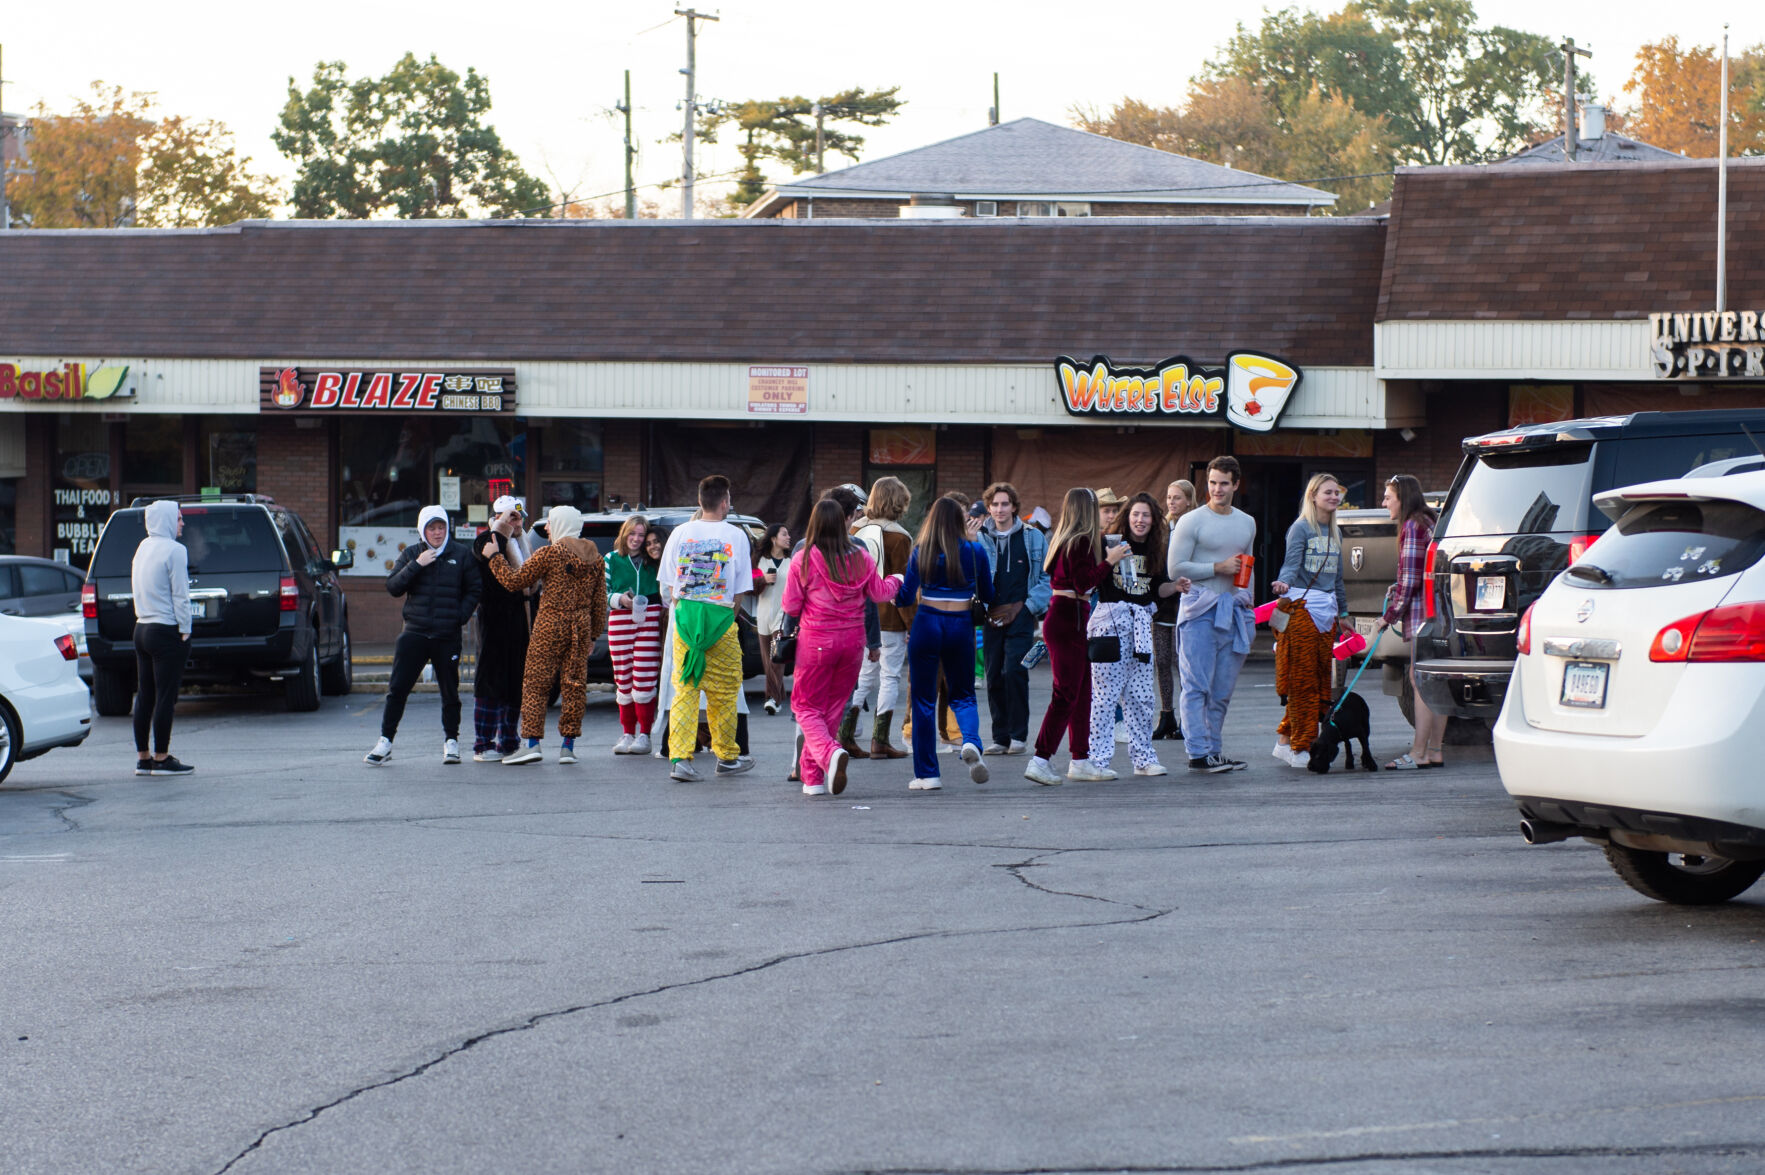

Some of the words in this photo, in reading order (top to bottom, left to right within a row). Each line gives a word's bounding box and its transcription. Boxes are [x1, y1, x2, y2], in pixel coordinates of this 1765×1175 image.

[1648, 311, 1765, 349] UNIVER
[0, 363, 86, 399] Basil
[751, 368, 791, 377] MONITORED
[793, 368, 807, 378] LOT
[310, 372, 445, 409] BLAZE
[763, 391, 793, 401] ONLY
[442, 394, 480, 410] CHINESE
[481, 395, 502, 411] BBQ
[485, 463, 512, 475] OPEN
[54, 489, 80, 505] THAI
[81, 489, 110, 505] FOOD
[77, 505, 85, 518] &
[57, 523, 105, 538] BUBBLE
[71, 538, 95, 554] TEA
